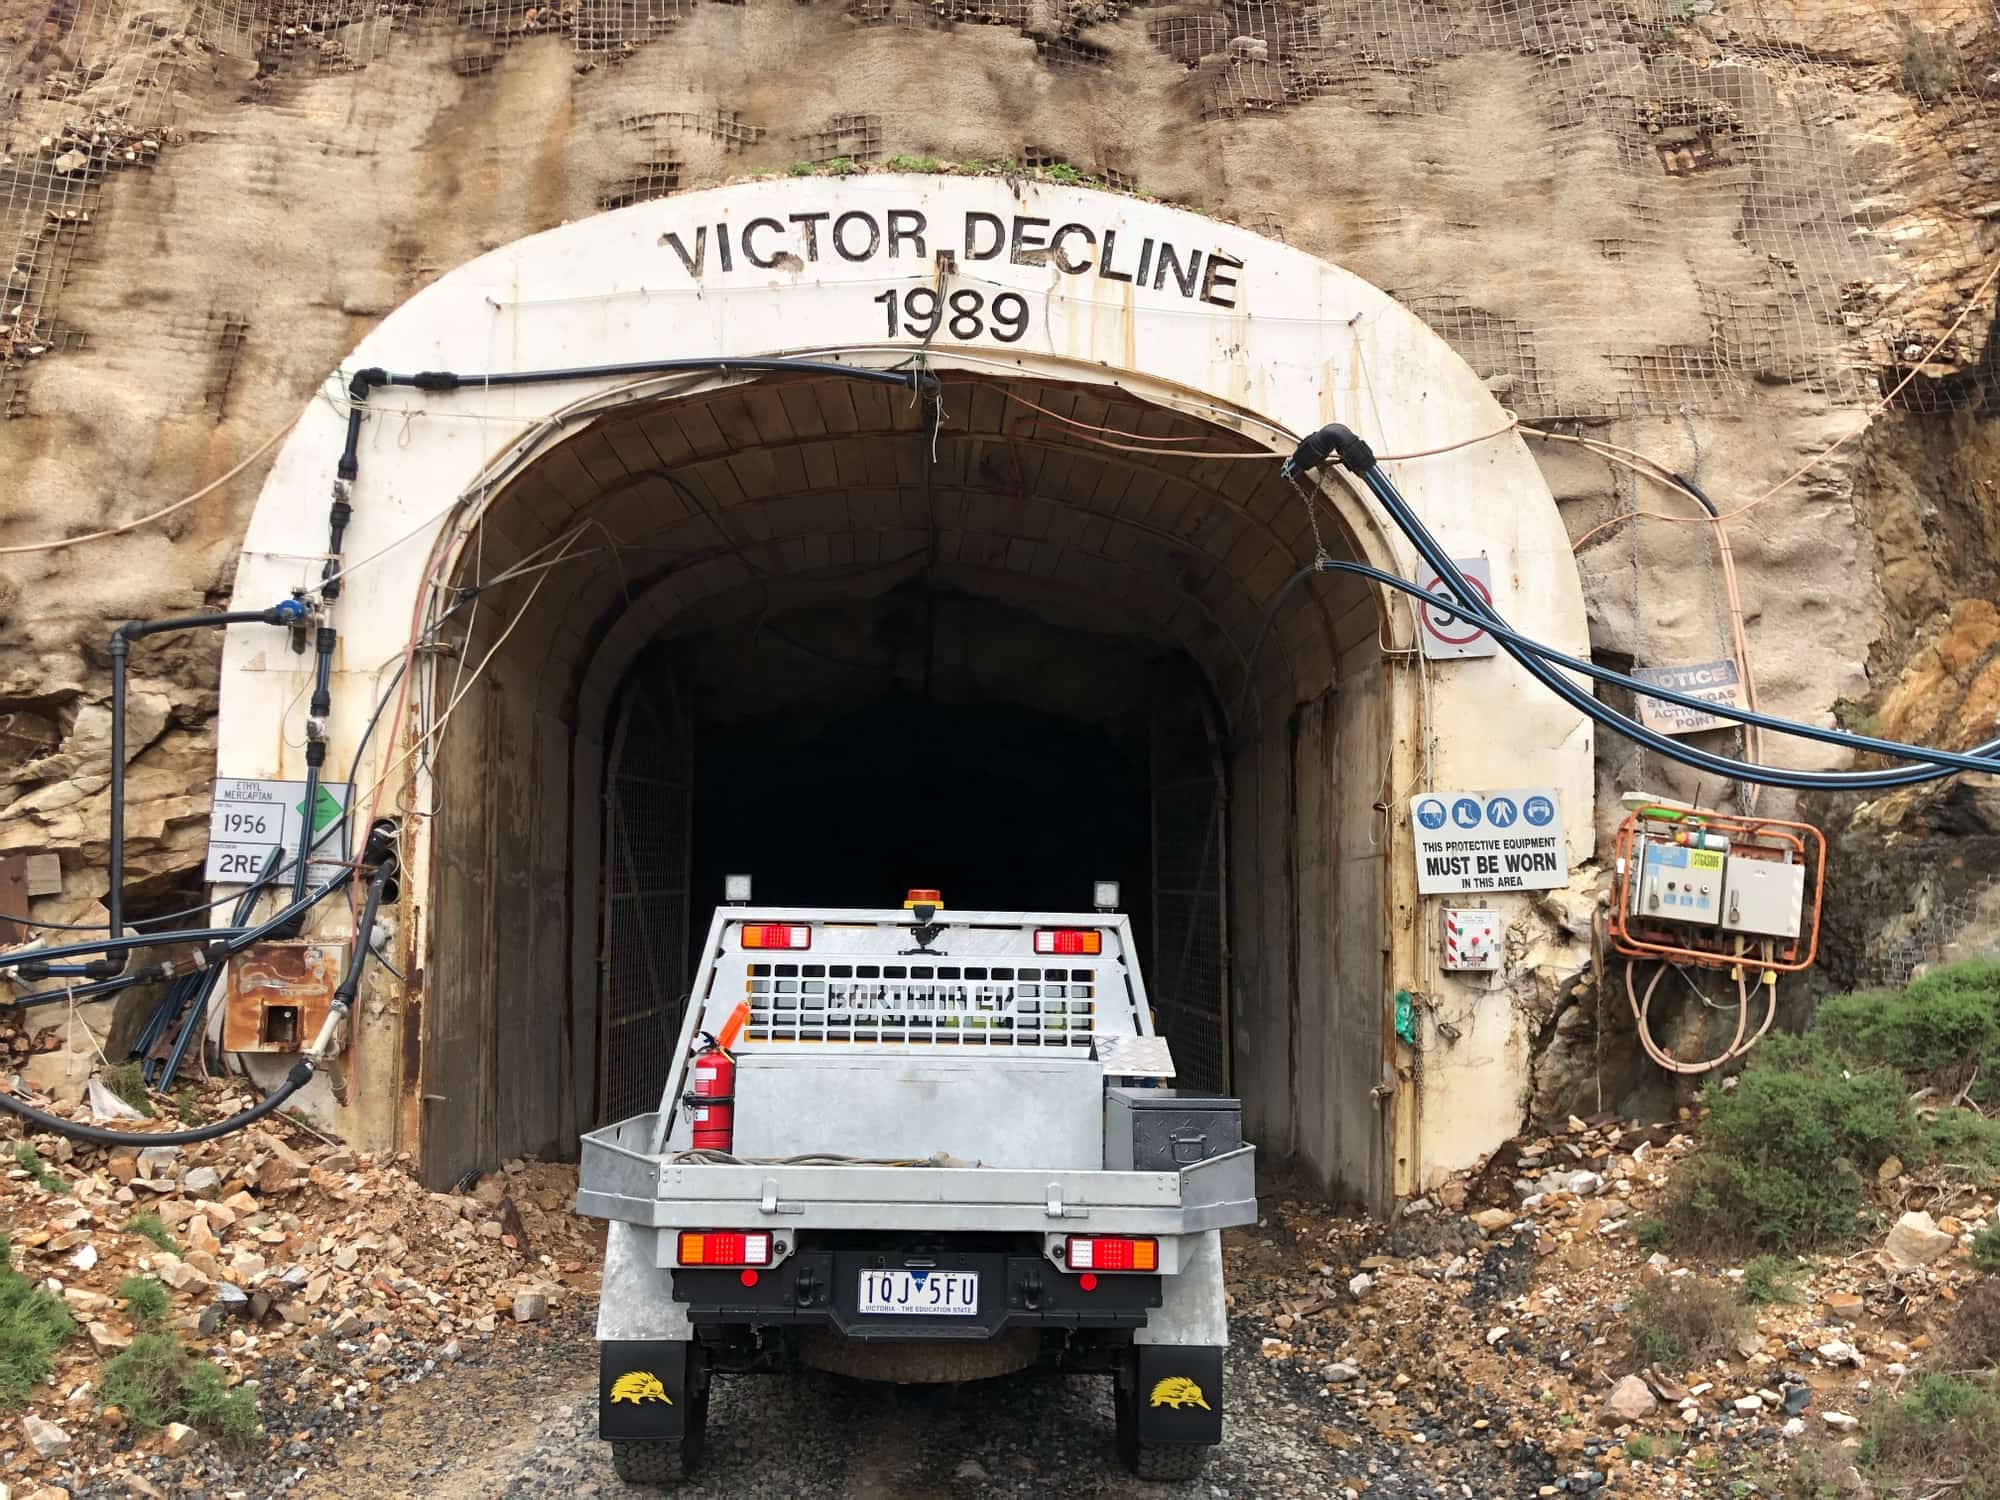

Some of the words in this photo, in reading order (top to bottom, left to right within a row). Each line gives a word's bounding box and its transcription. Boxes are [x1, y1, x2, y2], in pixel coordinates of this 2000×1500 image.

[662, 208, 928, 278] VICTOR
[963, 210, 1246, 310] DECLINE
[874, 287, 1029, 343] 1989
[1675, 714, 1718, 729] POINT
[224, 791, 273, 801] MERCAPTAN
[236, 781, 262, 792] ETHYL
[224, 813, 267, 834] 1956
[1422, 841, 1443, 853] THIS
[1445, 839, 1500, 852] PROTECTIVE
[1503, 836, 1557, 850] EQUIPMENT
[219, 853, 263, 874] 2RE
[1426, 856, 1470, 876] MUST
[1476, 855, 1500, 874] BE
[1505, 852, 1557, 873] WORN
[1461, 878, 1471, 889] IN
[1473, 877, 1494, 888] THIS
[1497, 876, 1524, 887] AREA
[929, 1278, 974, 1305] 5FU
